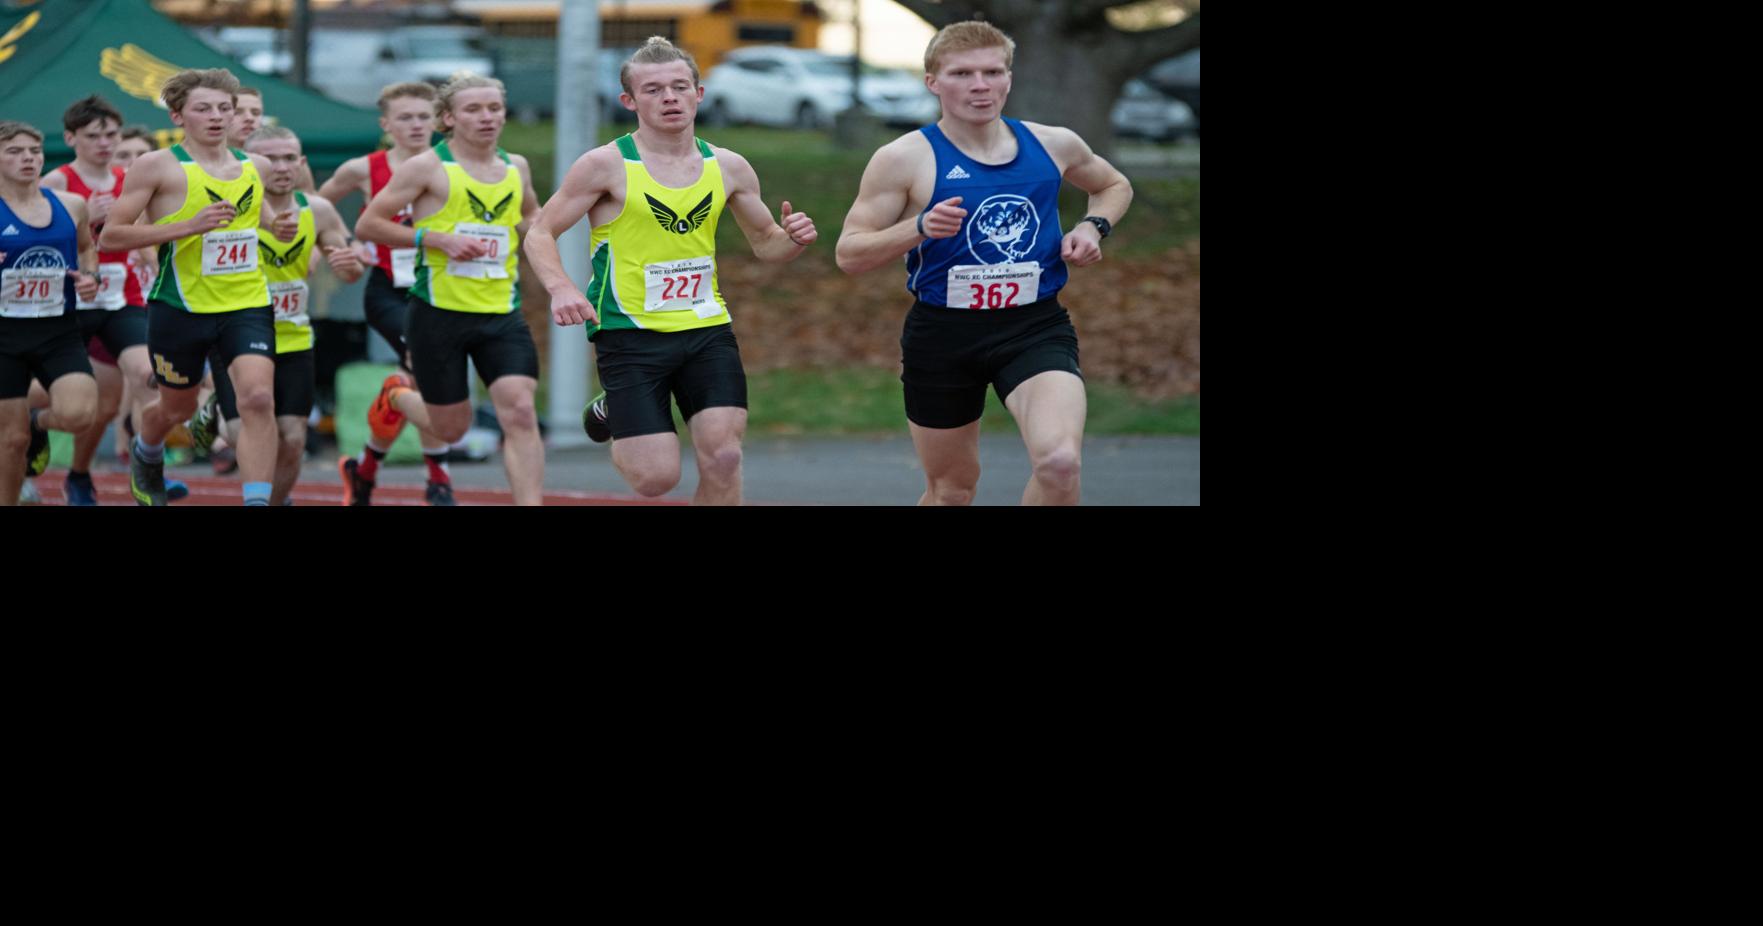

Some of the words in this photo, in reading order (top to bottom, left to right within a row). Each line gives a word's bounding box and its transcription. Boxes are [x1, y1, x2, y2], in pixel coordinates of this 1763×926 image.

[217, 243, 247, 266] 244
[15, 280, 50, 299] 370
[661, 273, 702, 301] 227
[969, 282, 1020, 310] 362
[272, 292, 299, 313] 245
